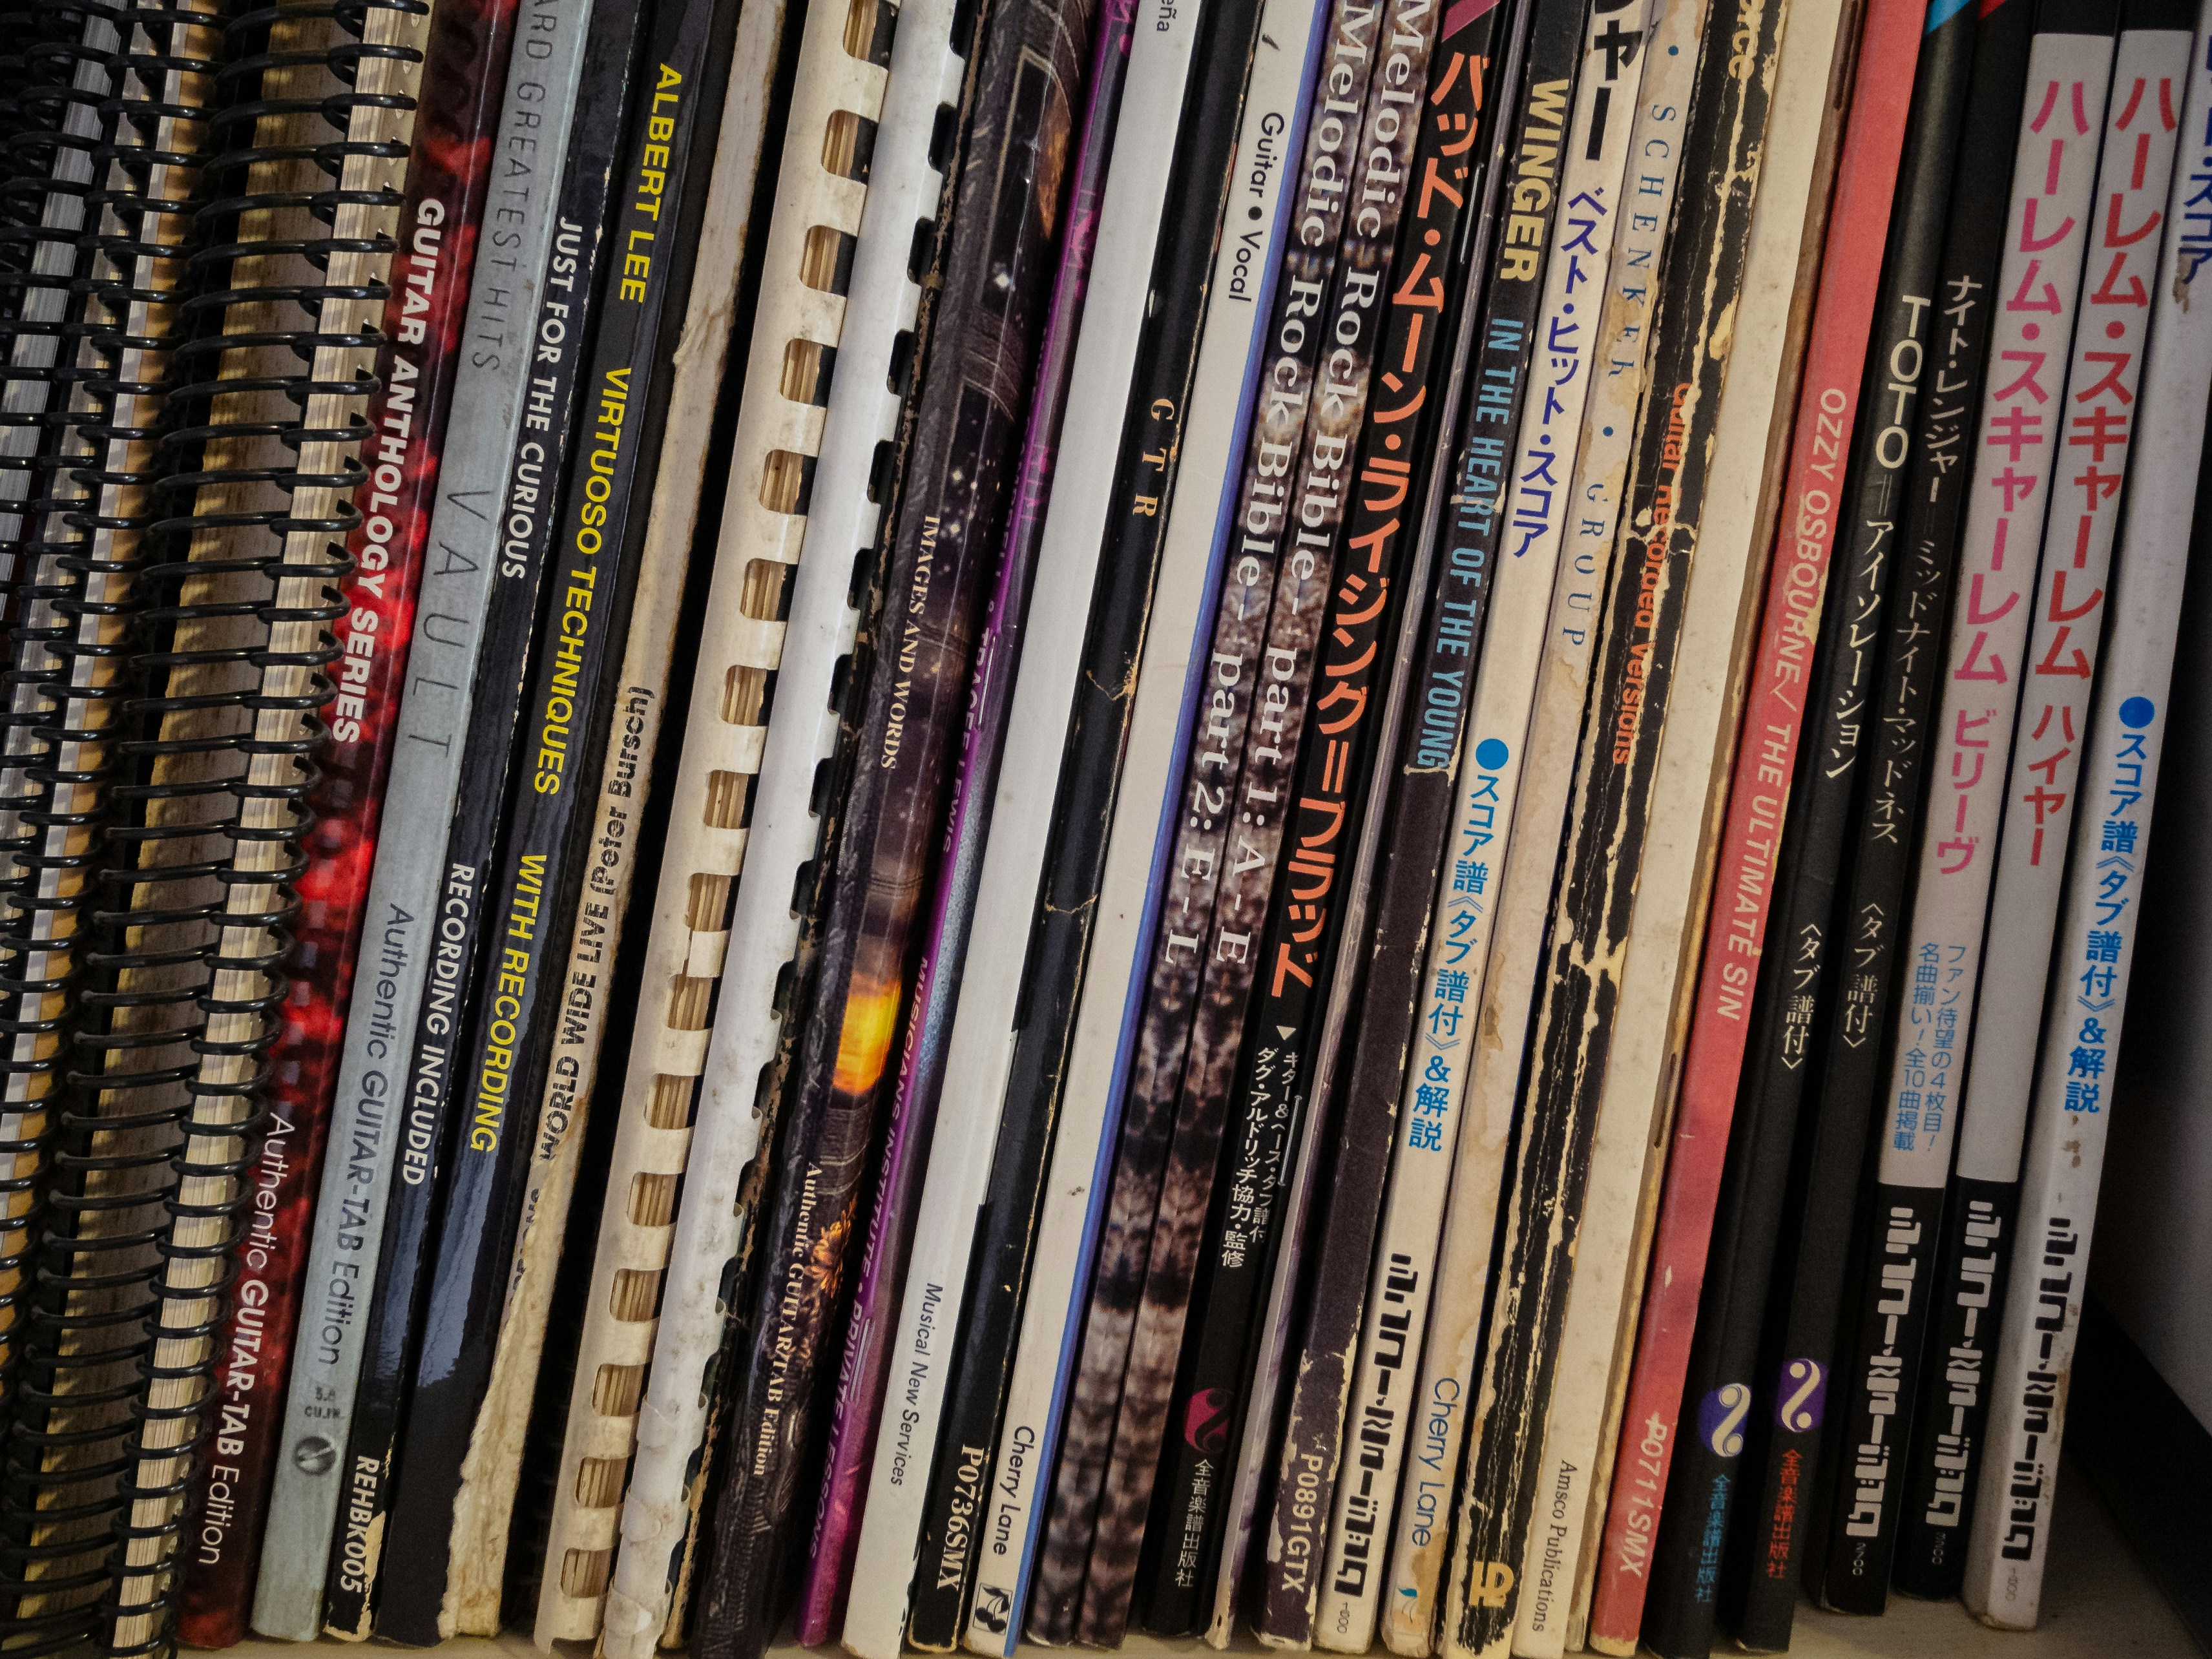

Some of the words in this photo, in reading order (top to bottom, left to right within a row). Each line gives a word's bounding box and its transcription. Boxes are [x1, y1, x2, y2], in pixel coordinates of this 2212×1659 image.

[490, 81, 546, 274] GREATEST
[635, 63, 682, 222] ALBERT
[1249, 112, 1285, 198] Guitar
[1300, 3, 1374, 247] Melodic
[1356, 0, 1437, 238] Melodic
[1499, 79, 1570, 282] WINGER
[396, 198, 444, 344] GUITAR
[547, 217, 583, 291] JUST
[619, 230, 655, 304] LEE
[1228, 231, 1264, 302] Vocal
[472, 287, 510, 372] HITS
[534, 299, 572, 362] FOR
[1265, 275, 1324, 432] Rock
[1319, 267, 1380, 427] Rock
[1488, 318, 1524, 351] IN
[1513, 186, 1608, 558] ベスト・ヒット・スコア
[1954, 81, 2089, 684] ハーレム・スキャーレム
[2034, 78, 2176, 680] ハーレム・スキャーレム
[522, 373, 559, 432] THE
[1476, 365, 1516, 425] THE
[1811, 388, 1846, 481] OZZY
[357, 355, 418, 599] ANTHOLOGY
[502, 443, 545, 579] CURIOUS
[576, 367, 632, 555] VIRTUOSO
[1236, 441, 1293, 587] Bible
[1291, 431, 1348, 581] Bible
[1459, 436, 1505, 537] HEART
[408, 489, 494, 758] VAULT
[908, 516, 940, 615] IMAGES
[1450, 548, 1485, 588] OF
[1562, 483, 1609, 647] GROUP
[333, 607, 379, 744] SERIES
[534, 567, 598, 795] TECHNIQUES
[899, 620, 921, 673] AND
[1436, 599, 1476, 658] THE
[881, 681, 912, 770] WORDS
[1202, 651, 1243, 769] part
[1255, 644, 1297, 765] part
[1417, 671, 1465, 769] YOUNG
[1758, 724, 1792, 788] THE
[1190, 782, 1225, 831] 2:
[1938, 709, 1997, 875] ビリーヴ
[2023, 704, 2074, 866] ハイヤー
[510, 853, 547, 941] WITH
[1727, 795, 1778, 955] ULTIMATE
[367, 903, 415, 1059] Authentic
[427, 863, 475, 1035] RECORDING
[1716, 962, 1748, 1021] SIN
[470, 952, 529, 1153] RECORDING
[540, 1056, 579, 1160] WORLD
[561, 970, 597, 1045] WIDE
[579, 901, 609, 963] LIVE
[335, 1070, 389, 1251] GUITAR-TAB
[402, 1044, 446, 1185] INCLUDED
[246, 1111, 295, 1270] Authentic
[791, 1162, 823, 1259] Authentic
[860, 1124, 897, 1278] INSTITUTE
[216, 1279, 269, 1456] GUITAR-TAB
[318, 1263, 359, 1365] Edition
[910, 1282, 943, 1356] Musical
[753, 1408, 780, 1476] Edition
[904, 1361, 929, 1404] New
[1419, 1377, 1460, 1471] Cherry
[890, 1409, 920, 1487] Services
[999, 1425, 1035, 1497] Cherry
[1552, 1460, 1578, 1519] Amsco
[199, 1465, 240, 1565] Edition
[341, 1455, 381, 1593] REHBK005
[937, 1444, 985, 1591] P0736SMX
[994, 1504, 1021, 1556] Lane
[1174, 1459, 1215, 1587] 全音楽譜出版社
[1281, 1453, 1324, 1593] P0891GTX
[1412, 1483, 1445, 1547] Lane
[1532, 1525, 1566, 1632] Publications
